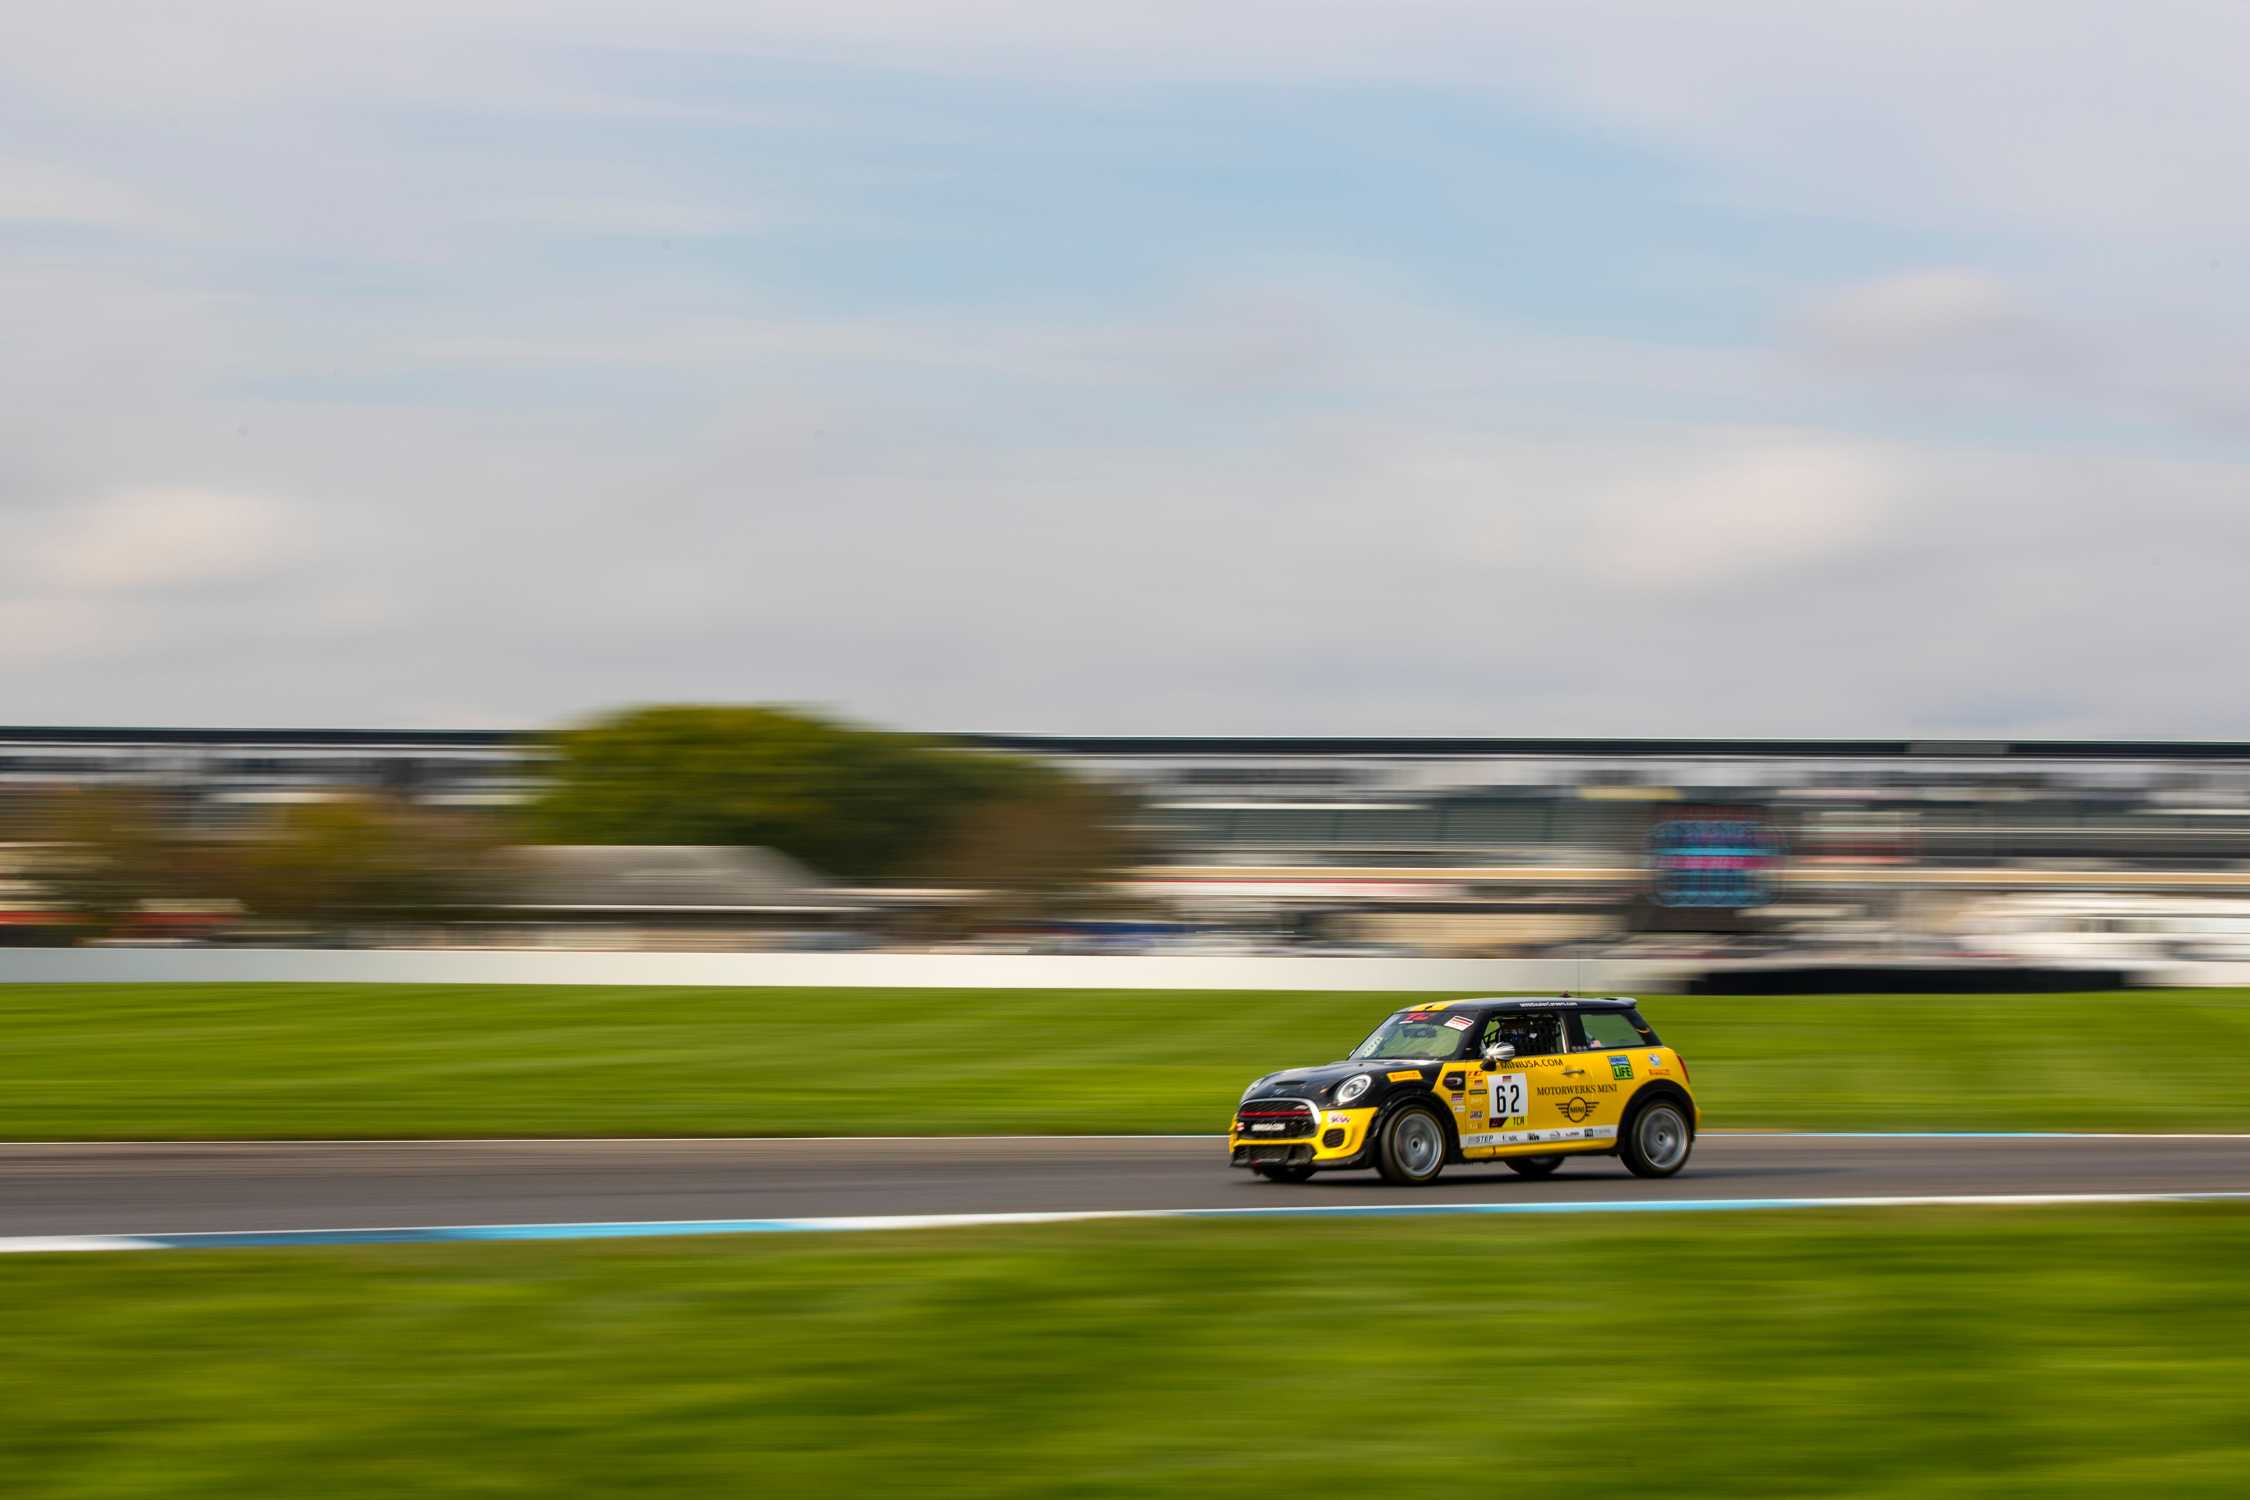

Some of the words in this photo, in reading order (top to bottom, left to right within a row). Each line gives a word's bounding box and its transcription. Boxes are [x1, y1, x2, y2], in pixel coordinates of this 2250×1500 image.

[1496, 1084, 1520, 1113] 62
[1536, 1084, 1596, 1096] MOTORWERKS
[1597, 1083, 1618, 1093] MINI
